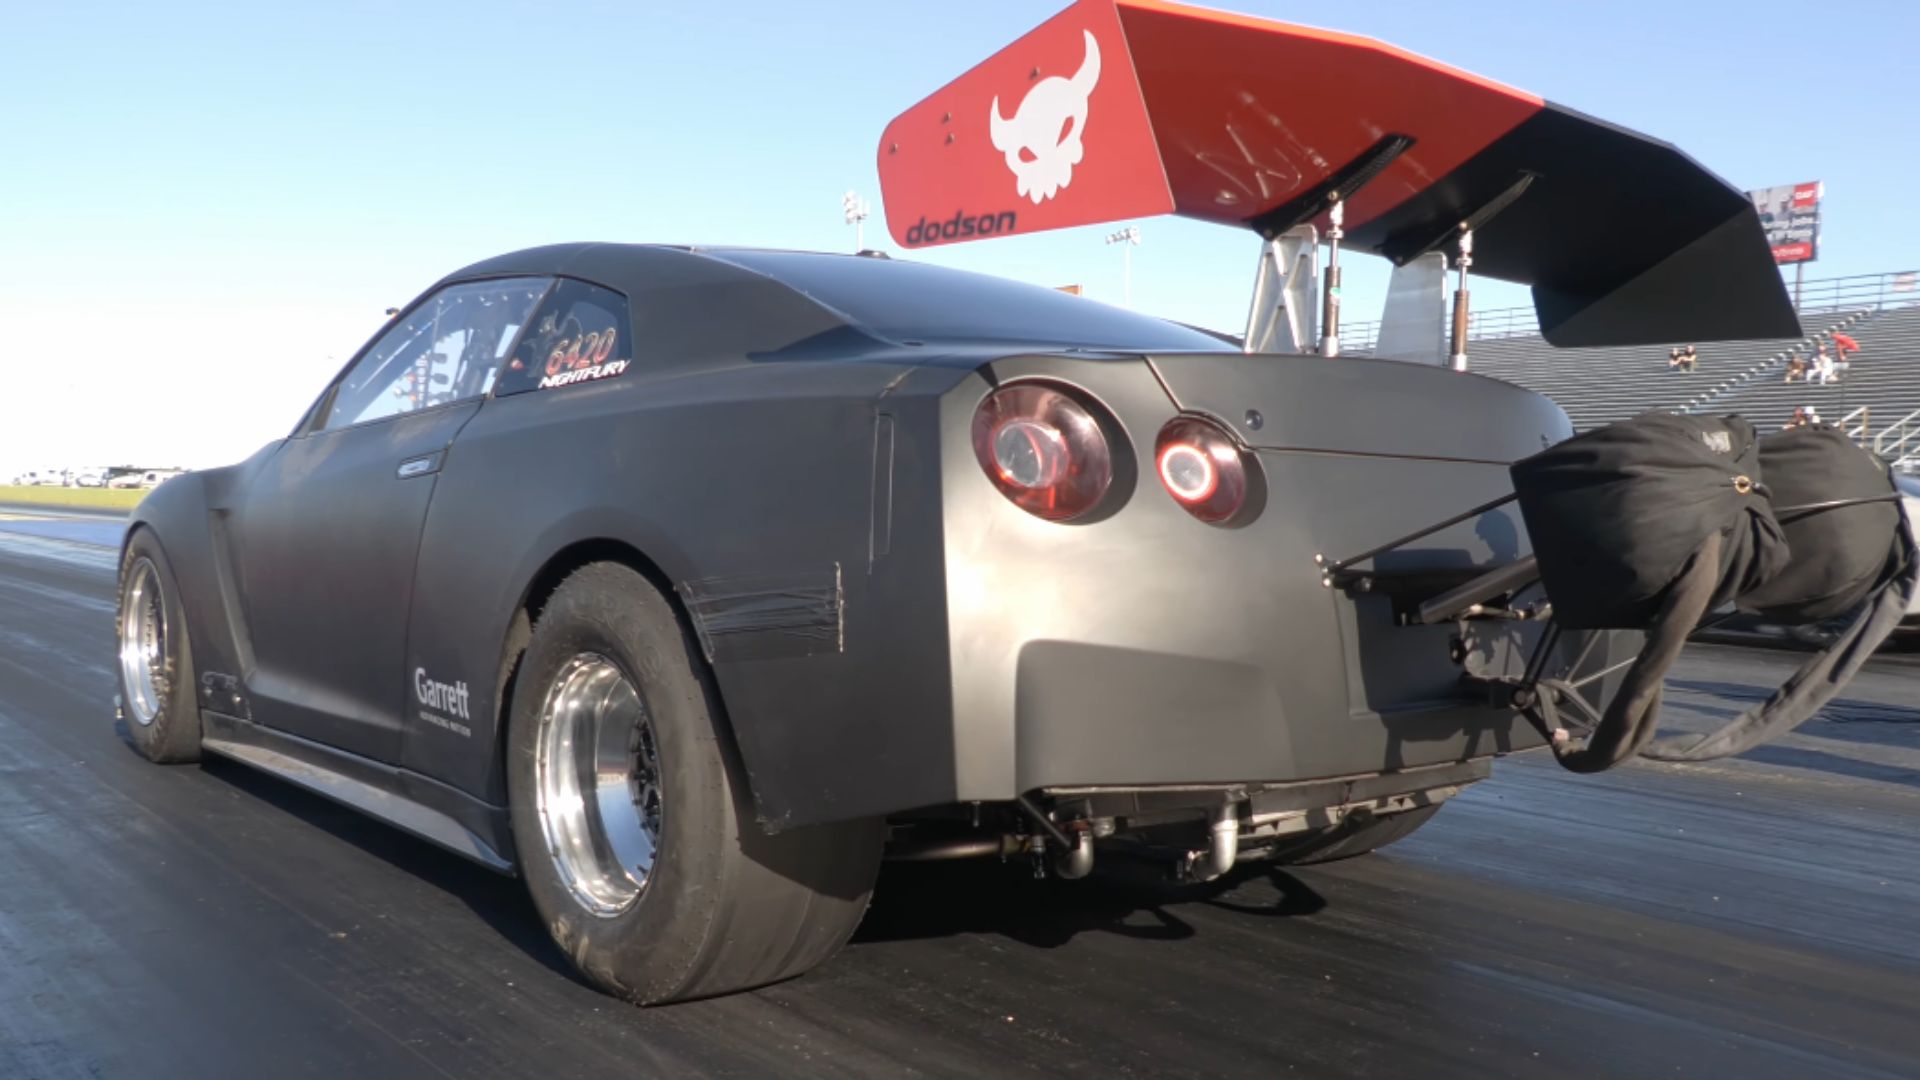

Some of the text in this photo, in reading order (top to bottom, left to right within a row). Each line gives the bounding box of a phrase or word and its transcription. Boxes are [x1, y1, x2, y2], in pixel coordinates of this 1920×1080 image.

[906, 210, 1016, 244] dodson
[545, 327, 616, 376] 6420
[538, 360, 631, 388] NIGHTFURY
[415, 667, 470, 720] Garrett
